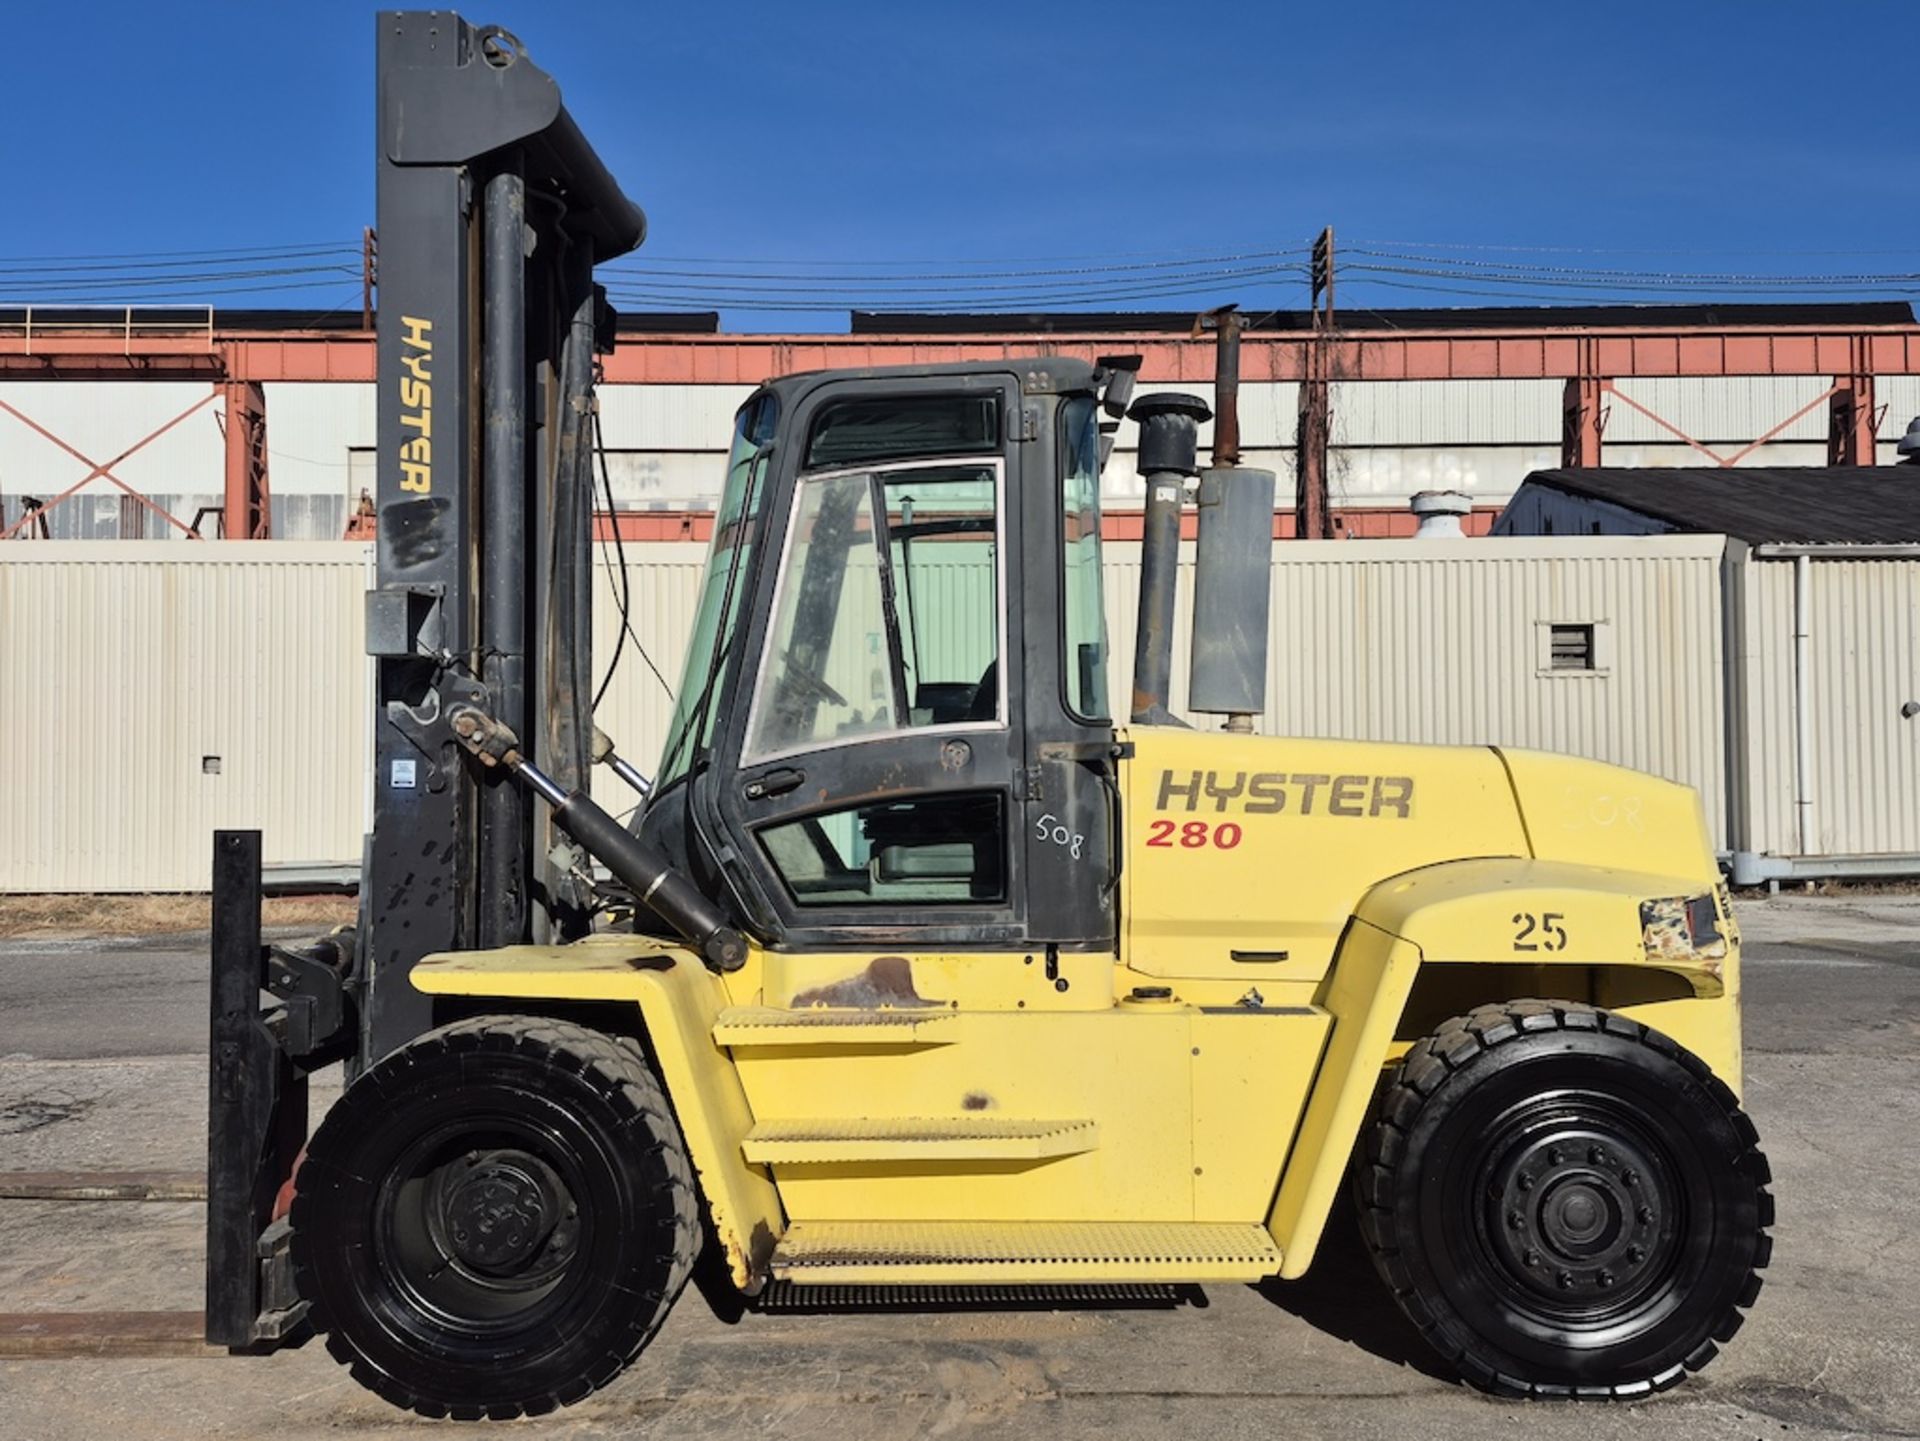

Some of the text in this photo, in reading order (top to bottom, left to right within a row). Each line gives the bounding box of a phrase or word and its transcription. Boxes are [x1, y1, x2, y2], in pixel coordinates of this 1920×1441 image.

[399, 315, 433, 496] HYSTER
[1155, 768, 1415, 819] HYSTER
[1035, 813, 1085, 860] 508
[1146, 819, 1243, 850] 280
[1511, 911, 1568, 952] 25
